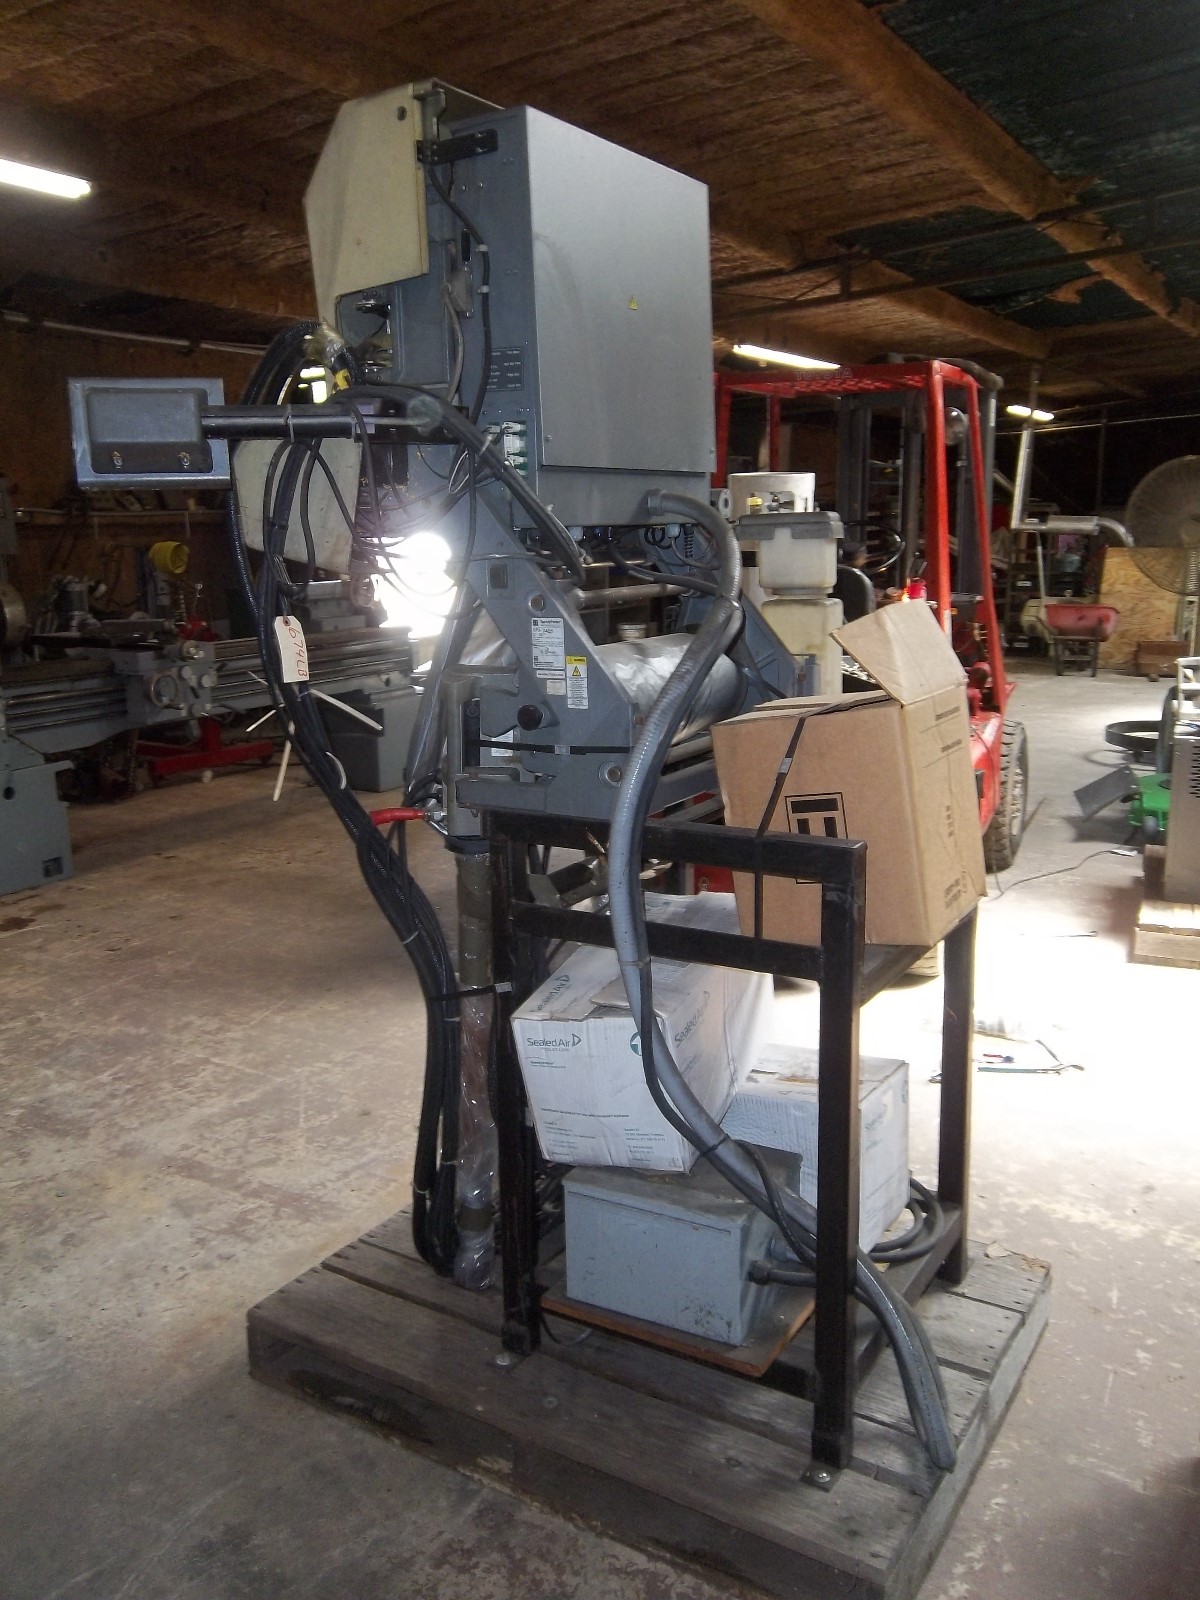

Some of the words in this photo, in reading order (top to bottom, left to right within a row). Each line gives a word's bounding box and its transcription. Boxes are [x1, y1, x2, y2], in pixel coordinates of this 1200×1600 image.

[794, 368, 853, 380] TOYOTA
[526, 1037, 557, 1047] Sealed
[558, 1038, 571, 1048] Air
